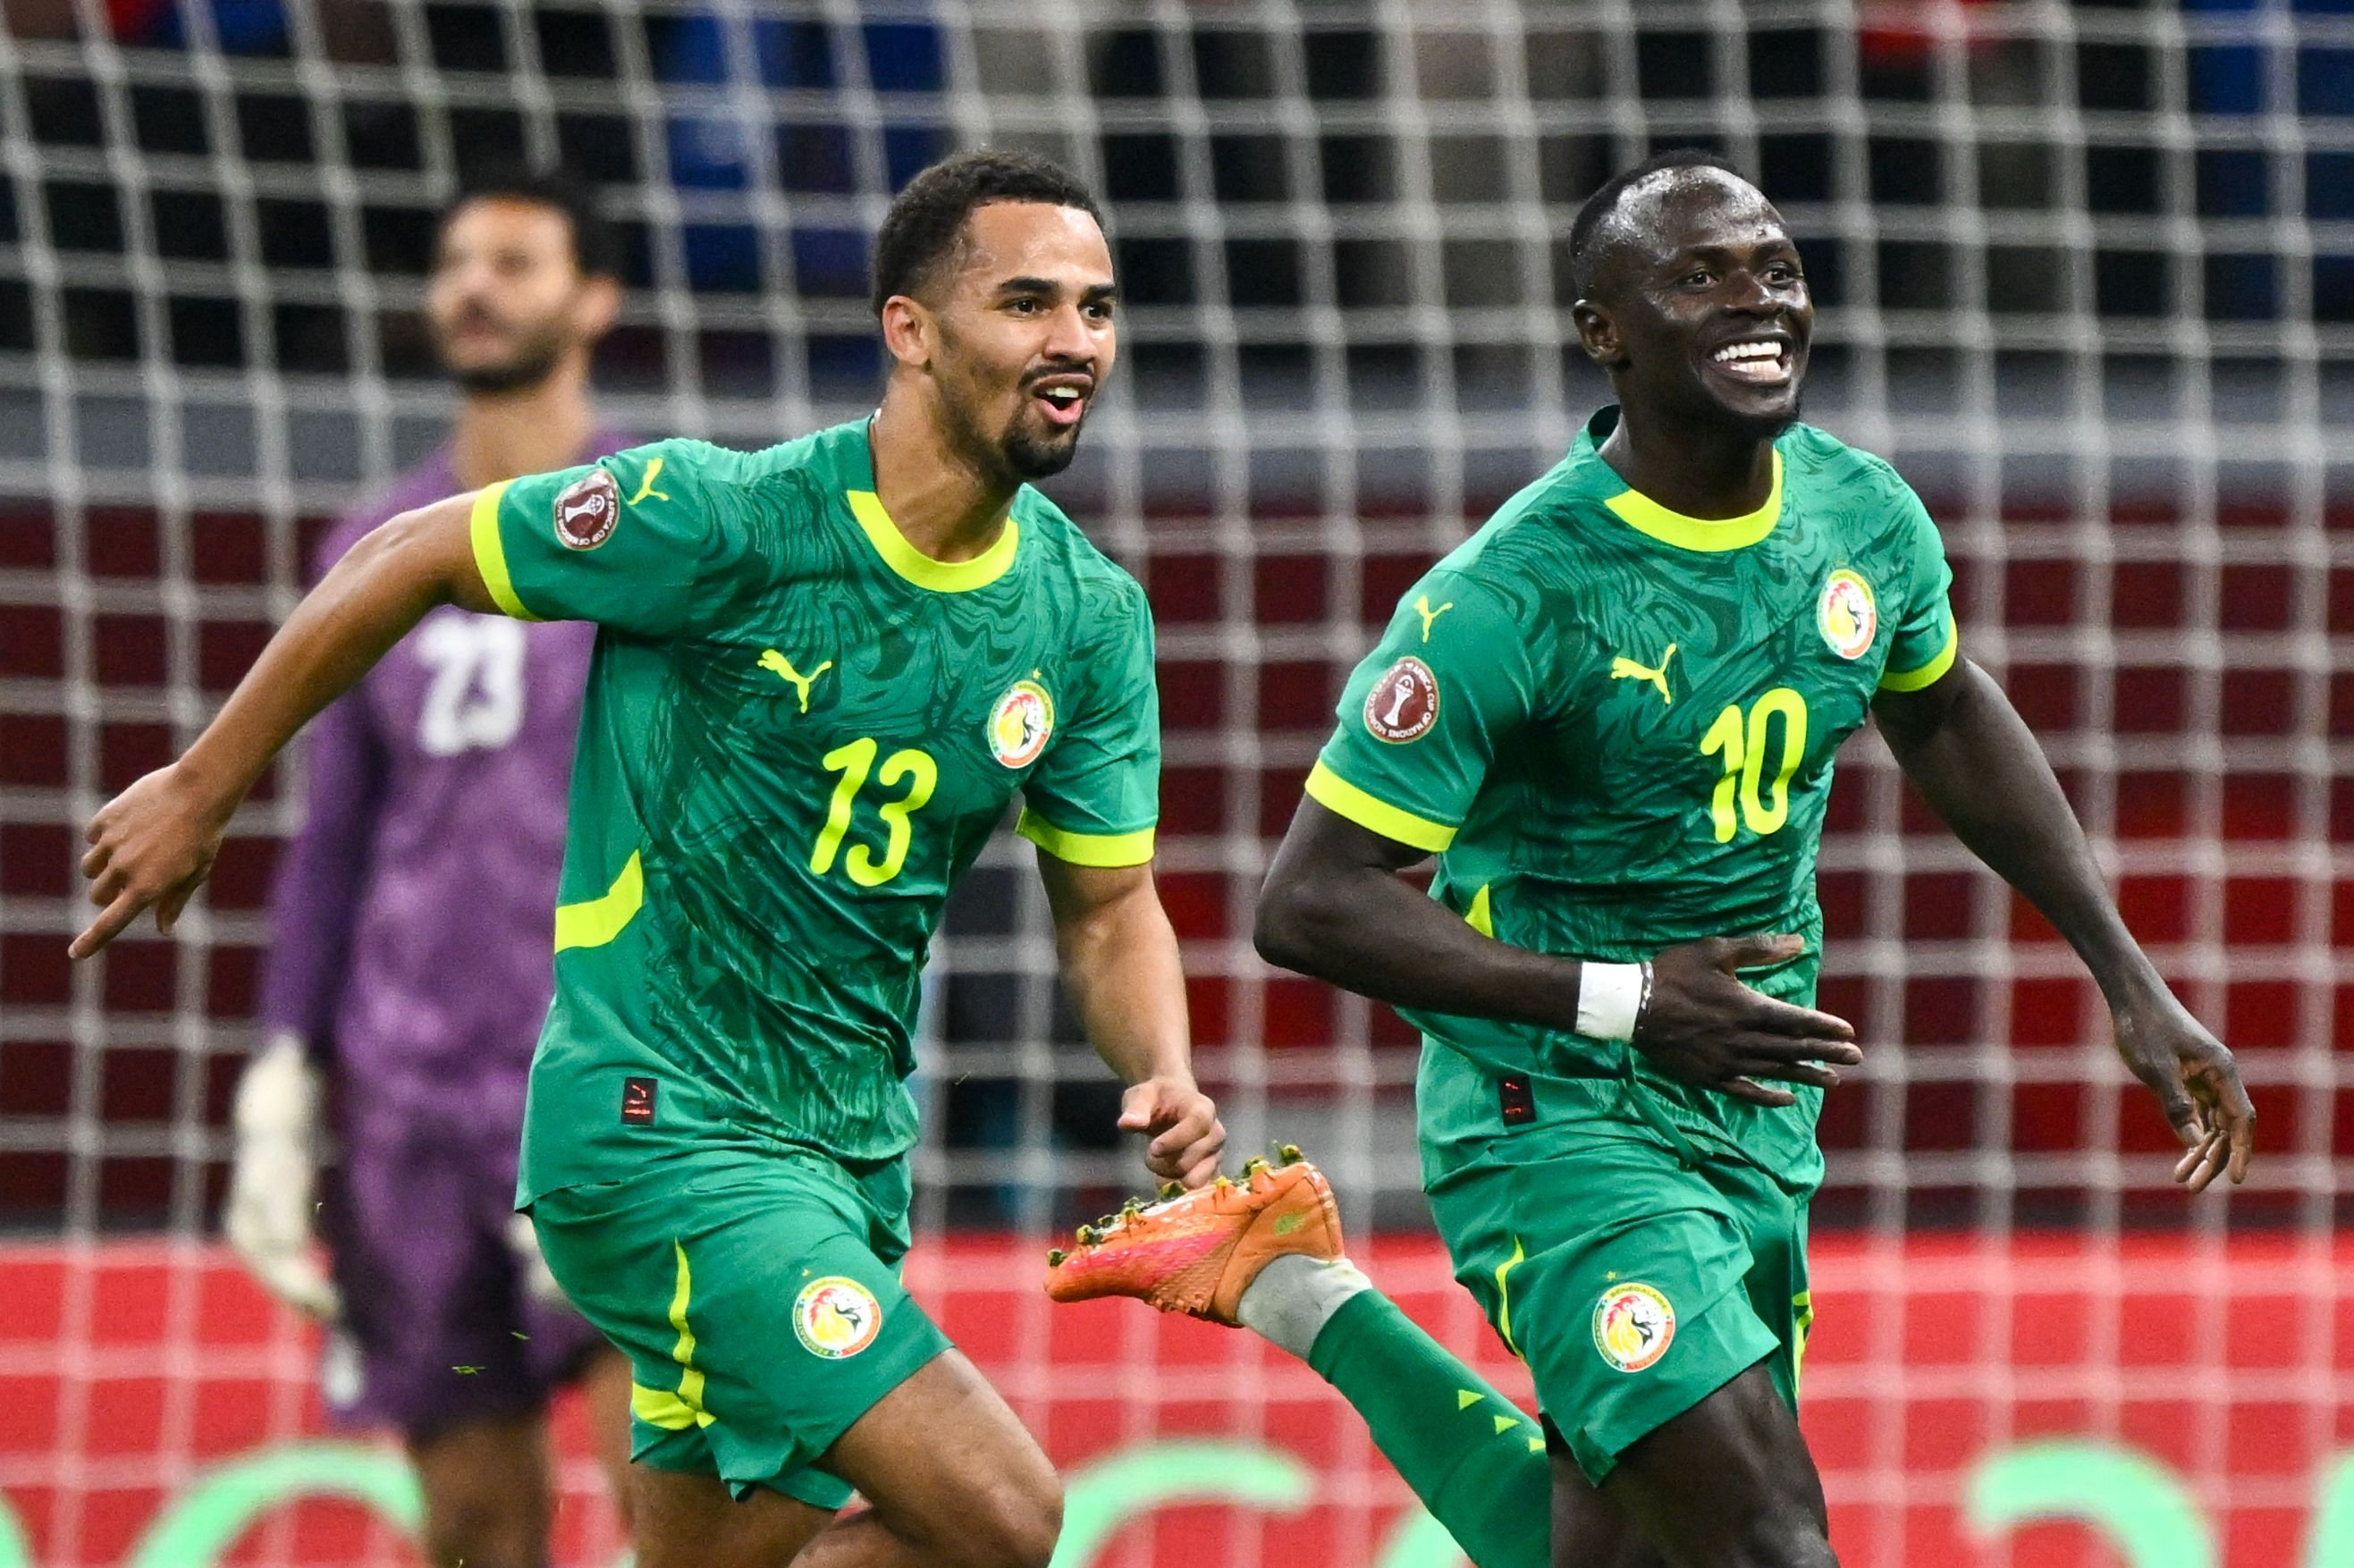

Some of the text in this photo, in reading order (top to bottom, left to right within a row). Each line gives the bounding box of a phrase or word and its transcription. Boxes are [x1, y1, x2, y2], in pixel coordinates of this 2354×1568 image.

[591, 529, 605, 543] CUP
[416, 614, 526, 754] 23
[1422, 712, 1432, 726] OF
[1427, 693, 1435, 712] CUP
[1700, 687, 1808, 844] 10
[810, 738, 938, 887] 13
